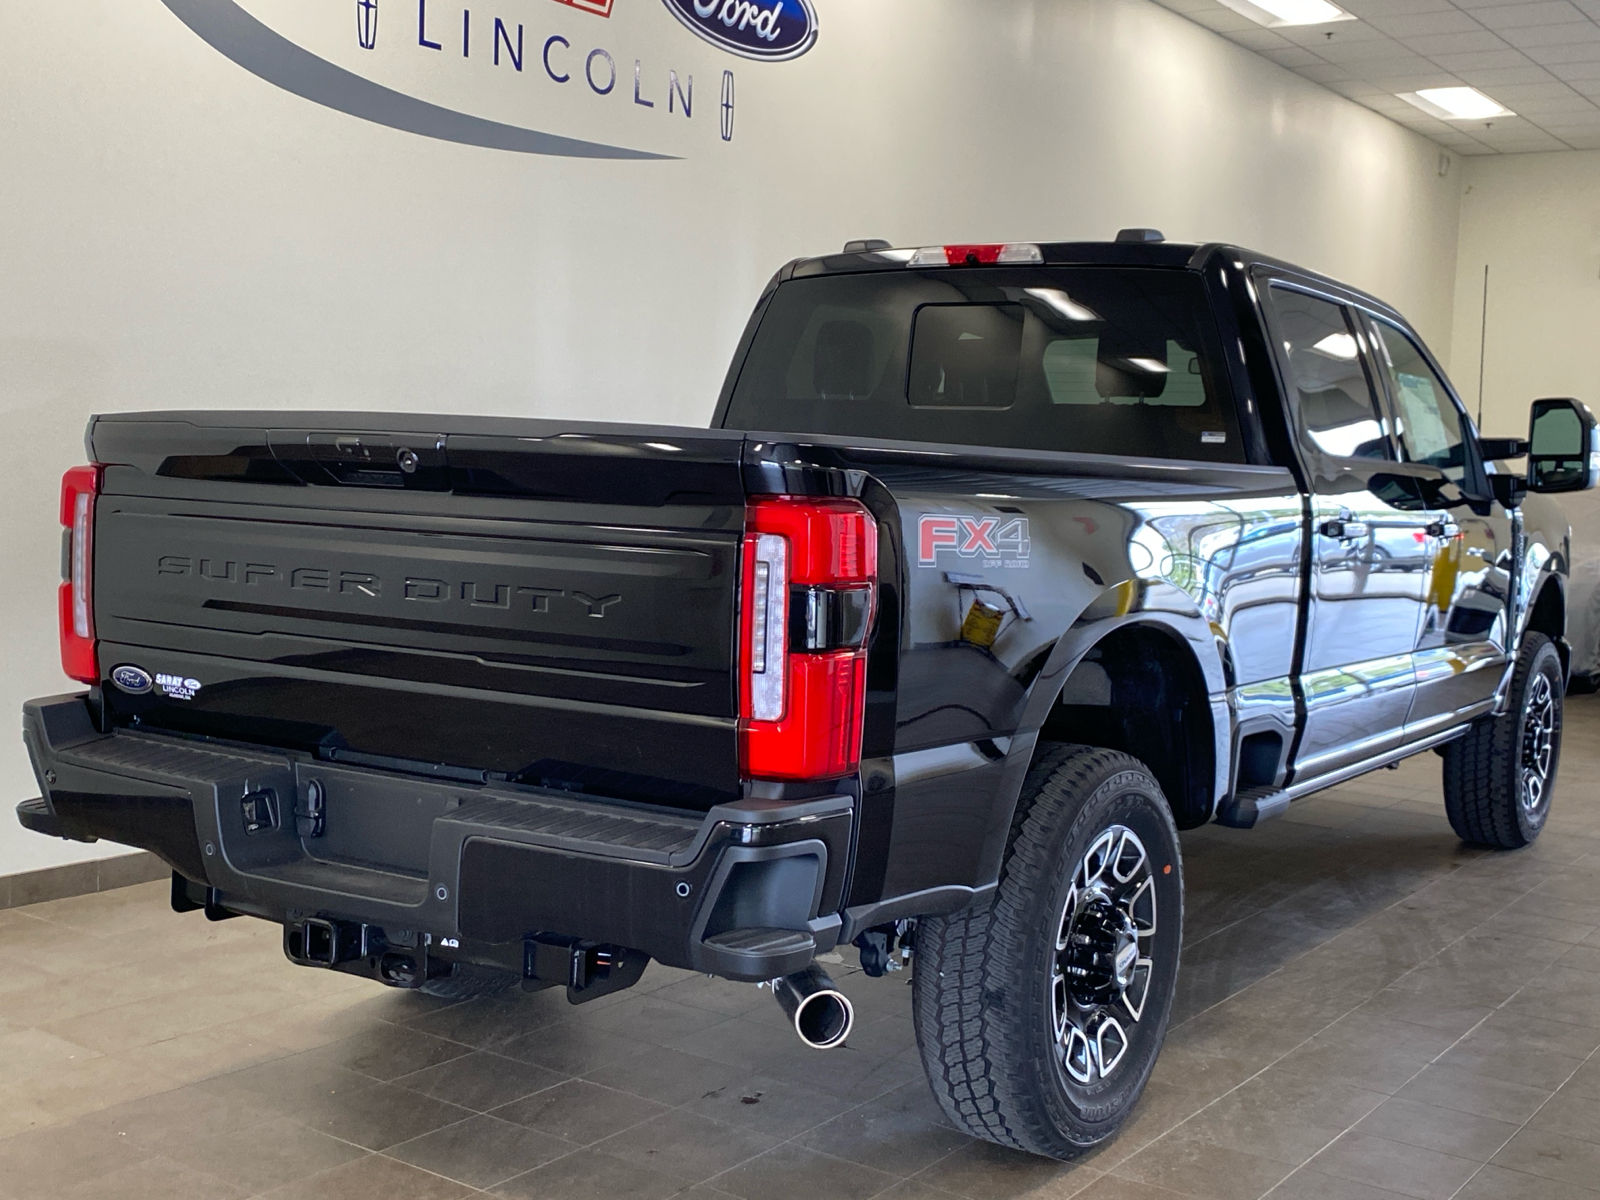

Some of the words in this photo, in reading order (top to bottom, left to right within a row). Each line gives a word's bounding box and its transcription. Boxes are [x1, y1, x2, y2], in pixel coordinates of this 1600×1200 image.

[418, 0, 693, 118] LINCOLN
[918, 513, 1031, 568] FX4
[158, 555, 382, 598] SUPER
[405, 577, 622, 618] DUTY
[162, 685, 195, 696] LINCOLN
